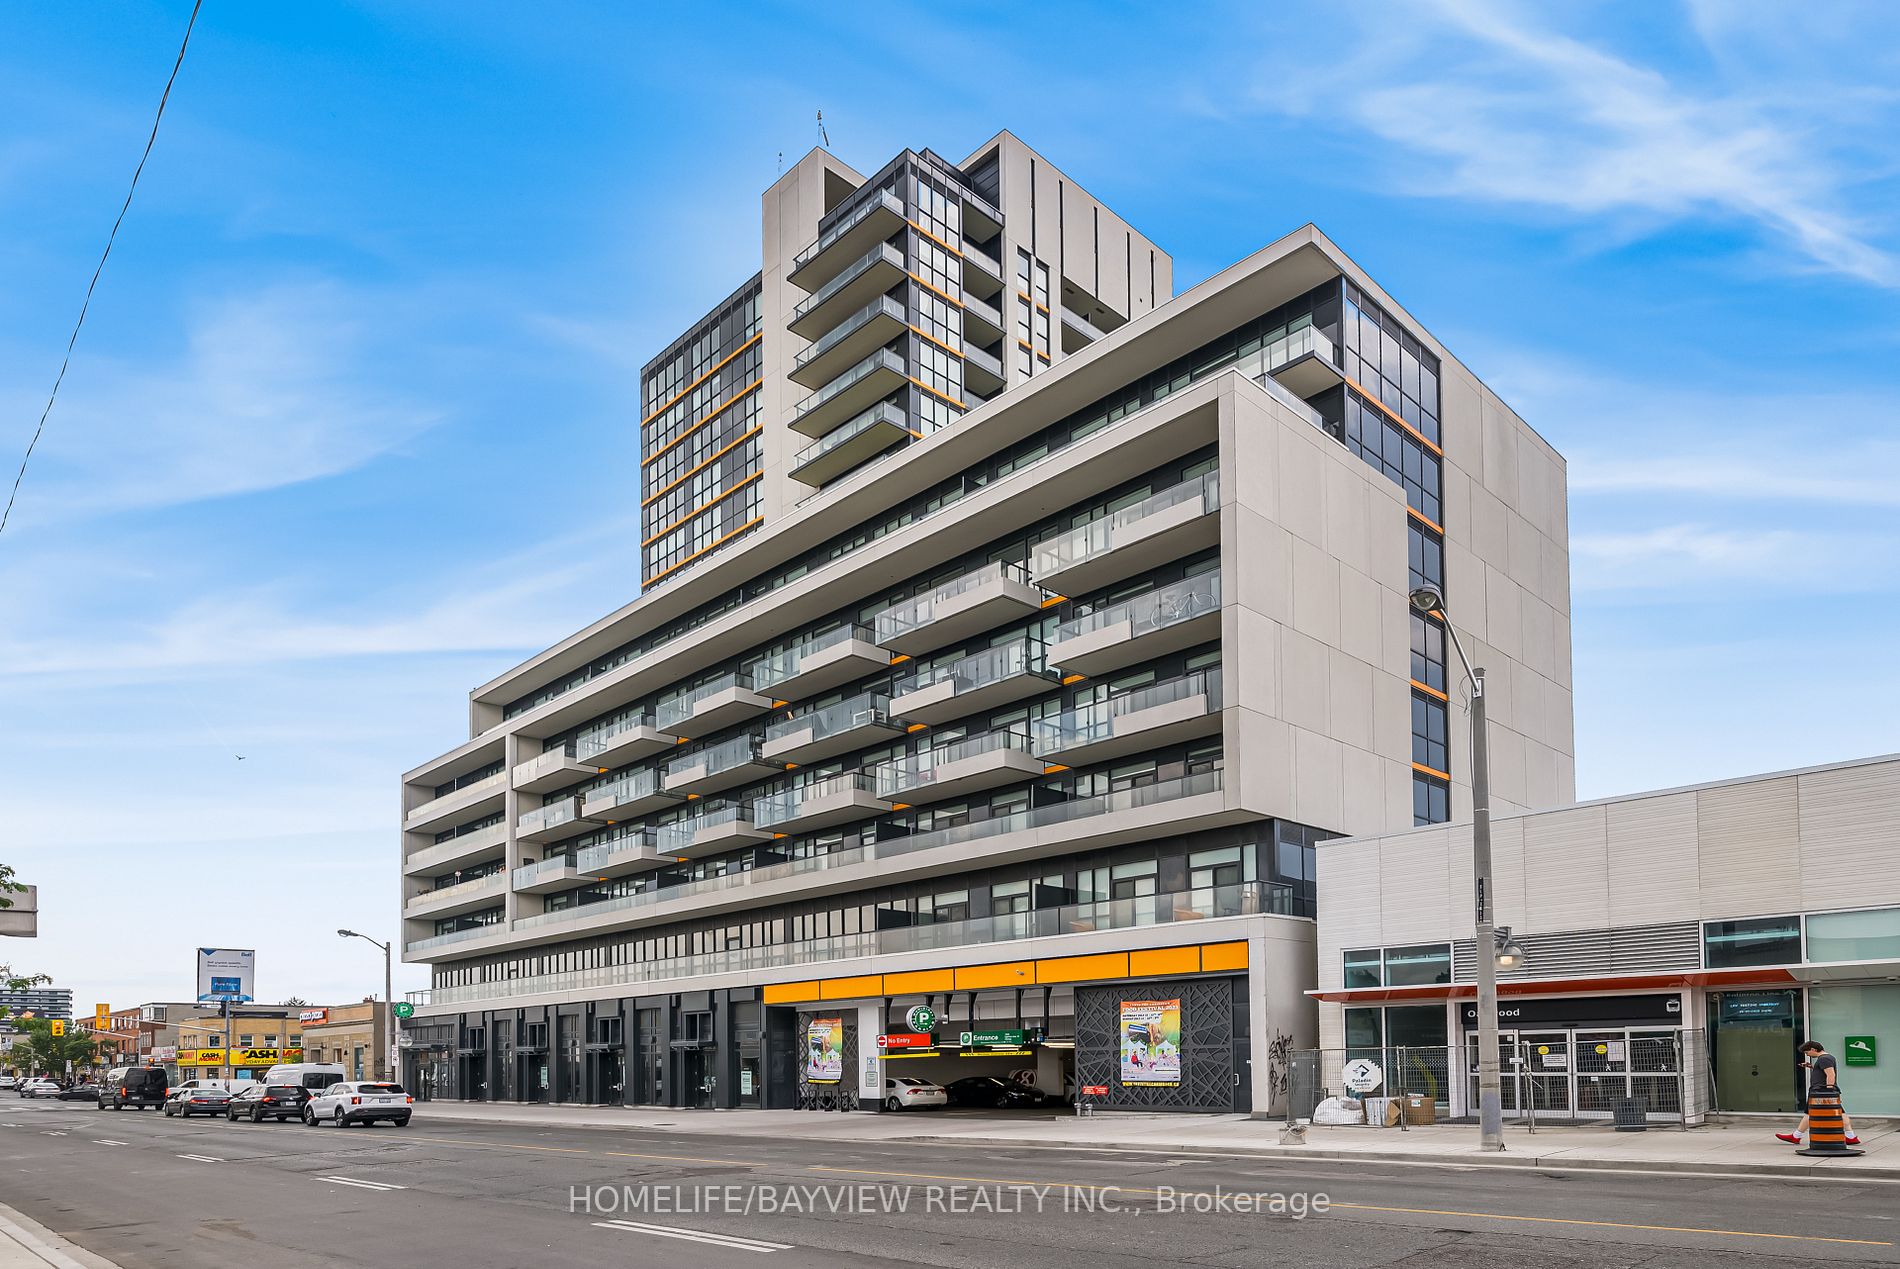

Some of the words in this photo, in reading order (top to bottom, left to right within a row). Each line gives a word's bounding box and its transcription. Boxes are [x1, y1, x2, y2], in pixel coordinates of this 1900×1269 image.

[399, 1005, 408, 1013] P
[1467, 1008, 1520, 1018] Oood
[919, 1012, 930, 1023] P
